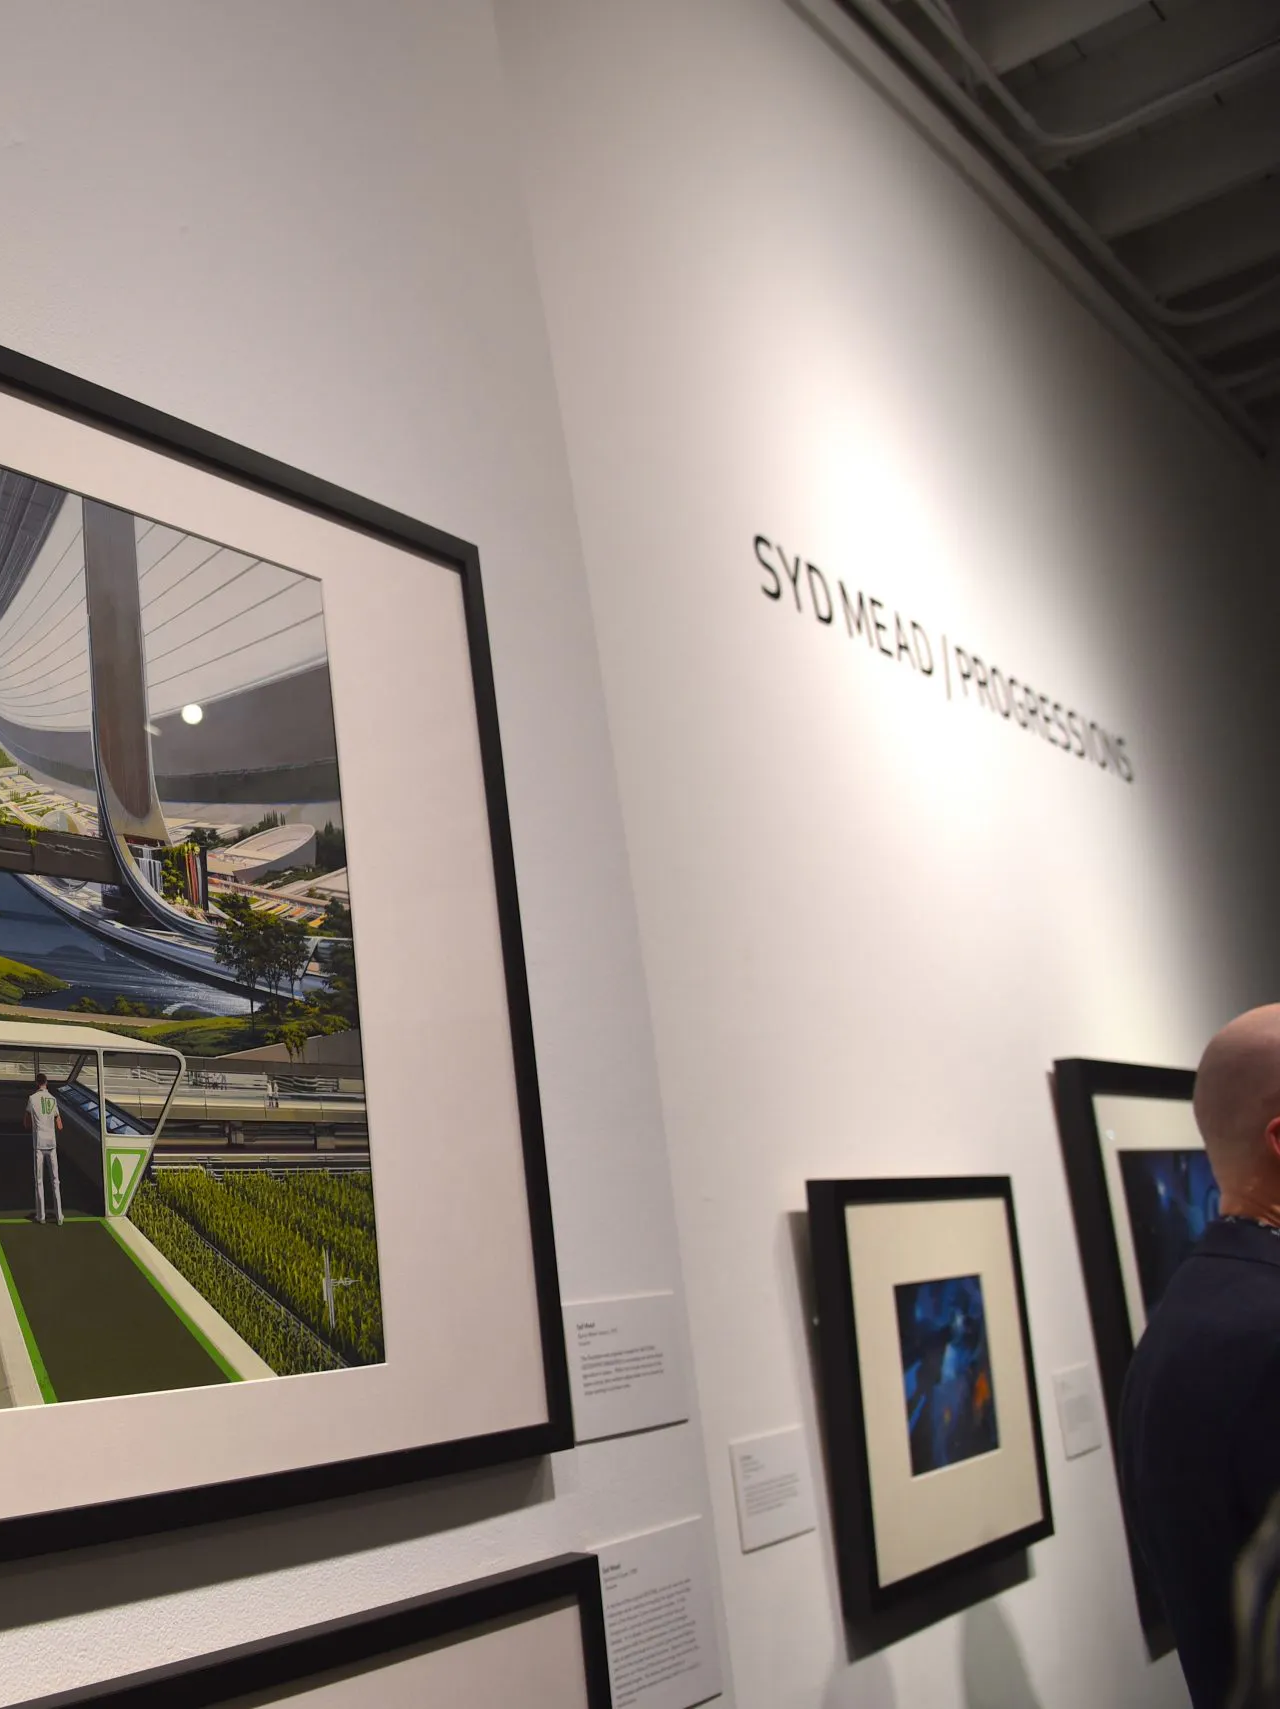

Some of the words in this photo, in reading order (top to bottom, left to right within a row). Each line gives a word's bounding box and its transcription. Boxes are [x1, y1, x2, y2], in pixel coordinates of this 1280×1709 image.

[753, 534, 834, 626] SYD
[838, 579, 934, 677] MEAD
[954, 645, 1135, 784] PROGRESSIONS
